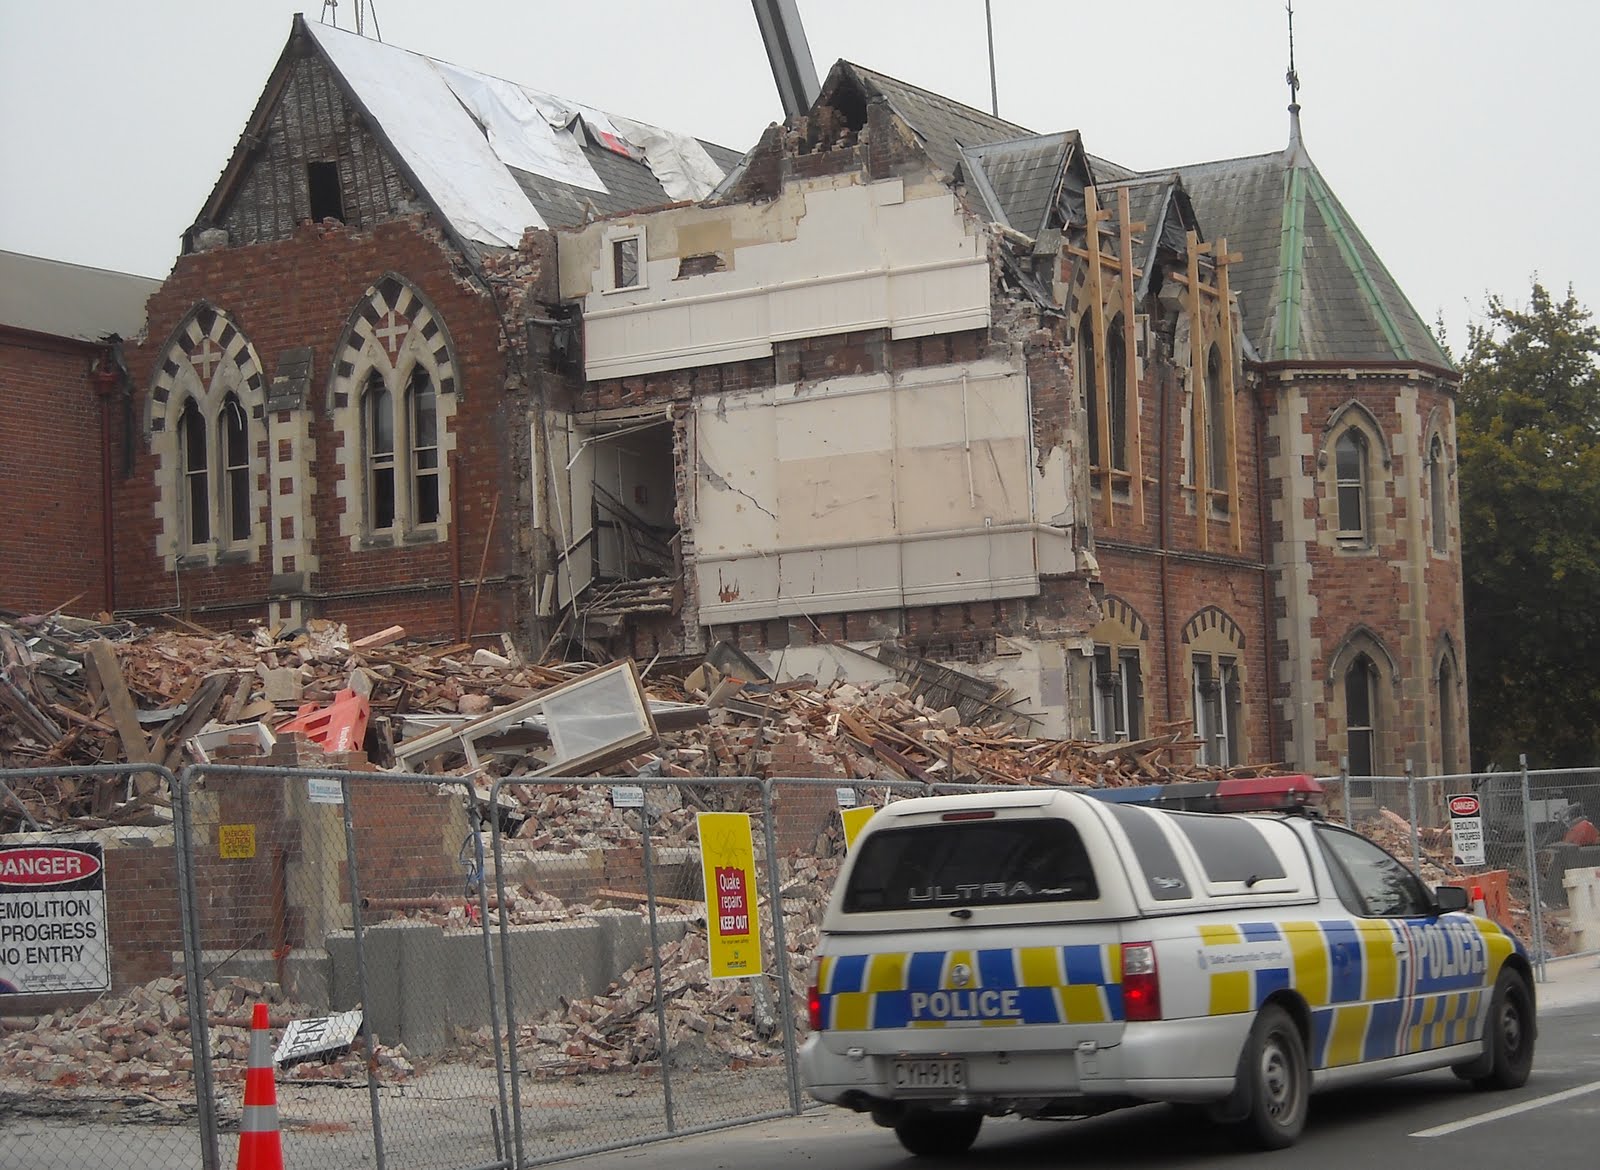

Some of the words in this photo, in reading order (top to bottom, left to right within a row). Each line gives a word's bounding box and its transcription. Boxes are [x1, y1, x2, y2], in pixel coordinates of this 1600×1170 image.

[1453, 801, 1475, 811] DANGER
[1454, 821, 1479, 831] DEMOLITION
[1459, 831, 1481, 841] PROGRESS
[0, 857, 82, 876] ANGER
[720, 872, 740, 892] Quake
[908, 881, 1033, 901] ULTRA
[721, 891, 743, 912] repairs
[2, 922, 97, 942] PROGRESS
[720, 916, 735, 930] KEEP
[736, 915, 748, 930] OUT
[26, 945, 84, 964] ENTRY
[1410, 922, 1487, 980] POLICE
[911, 989, 1022, 1018] POLICE
